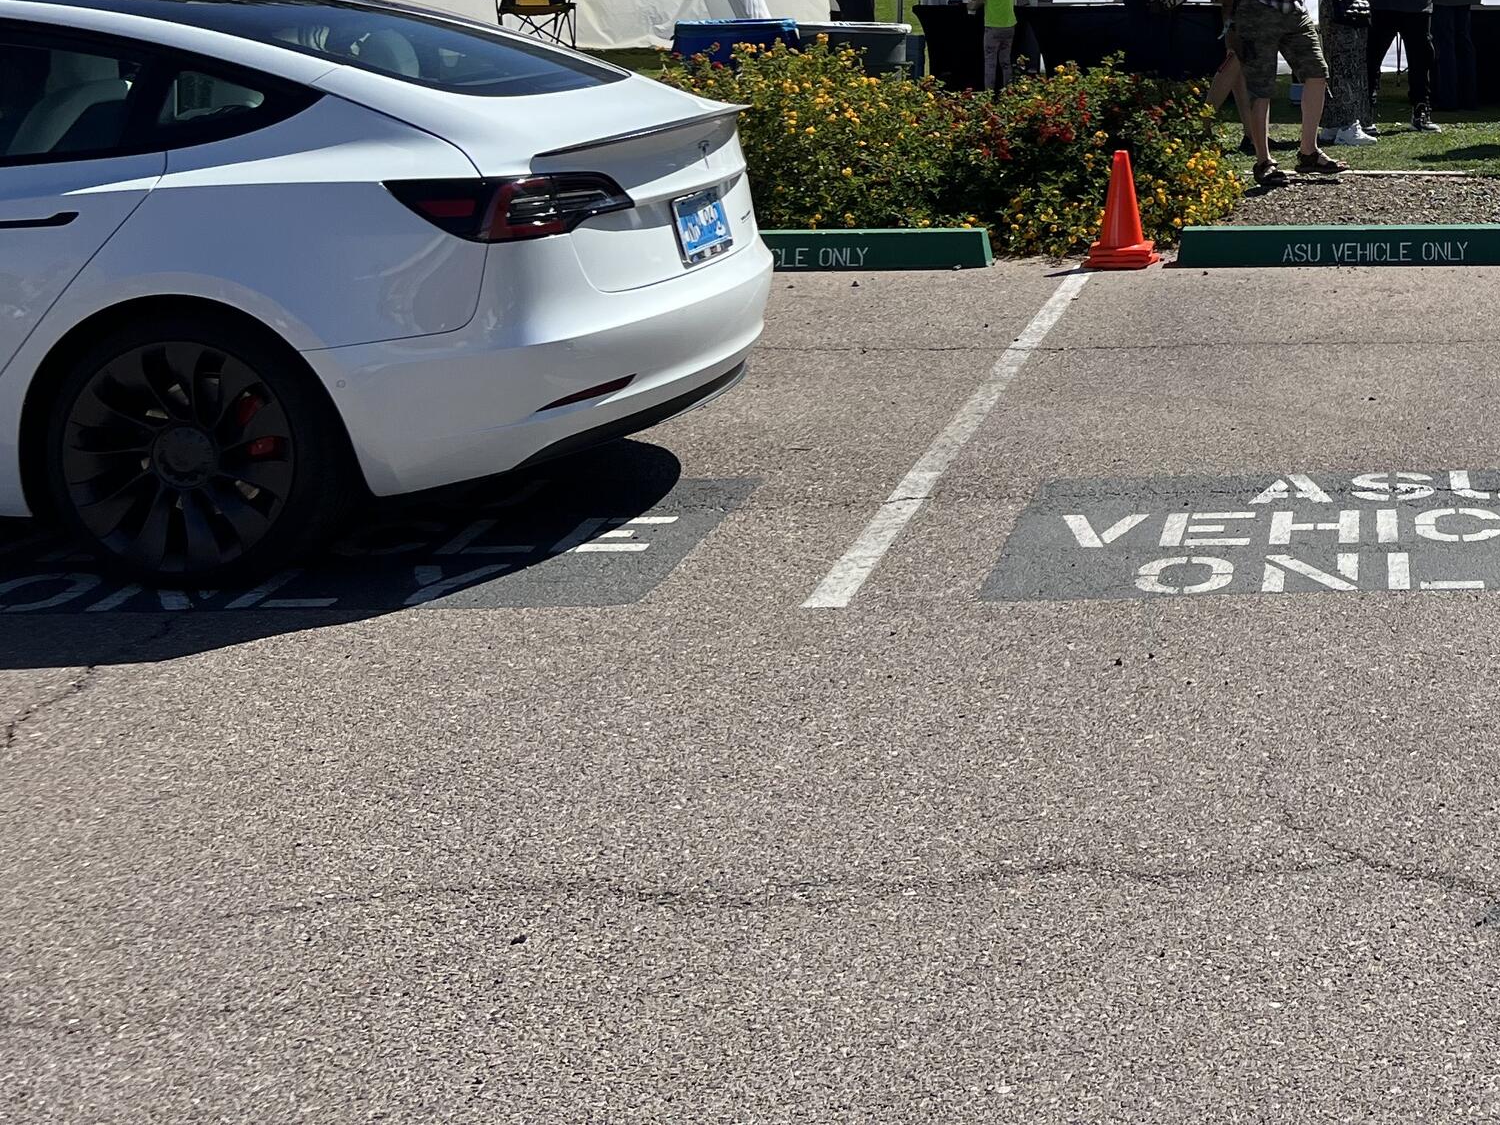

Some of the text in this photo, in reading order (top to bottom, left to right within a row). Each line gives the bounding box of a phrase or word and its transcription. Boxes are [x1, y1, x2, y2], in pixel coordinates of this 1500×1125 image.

[818, 247, 869, 267] ONLY
[1282, 241, 1468, 263] ASU VEHICLE ONLY
